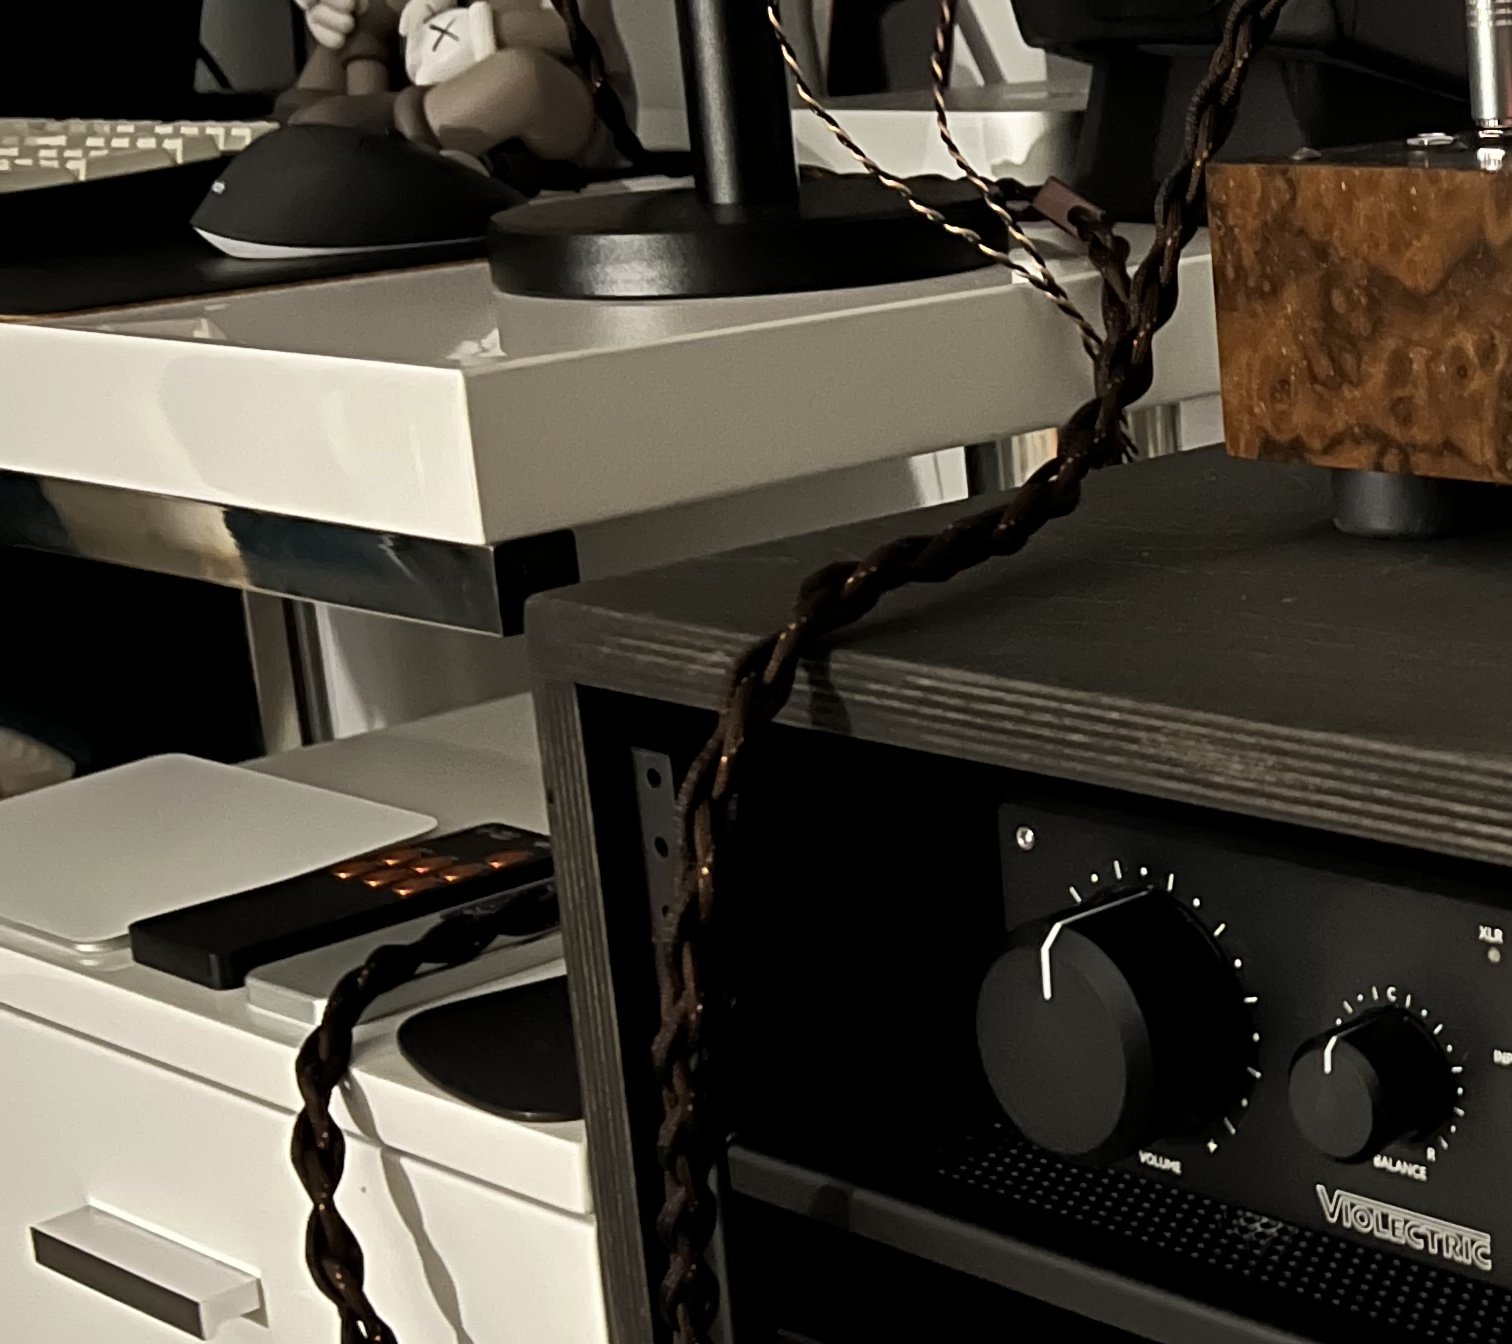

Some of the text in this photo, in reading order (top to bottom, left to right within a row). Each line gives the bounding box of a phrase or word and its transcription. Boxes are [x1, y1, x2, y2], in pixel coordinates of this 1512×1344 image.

[1478, 925, 1504, 944] XLR
[1138, 1150, 1182, 1175] VOLUME
[1426, 1146, 1436, 1162] R
[1373, 1154, 1427, 1181] BALANCE
[1315, 1183, 1493, 1271] VIOLECTRIC
